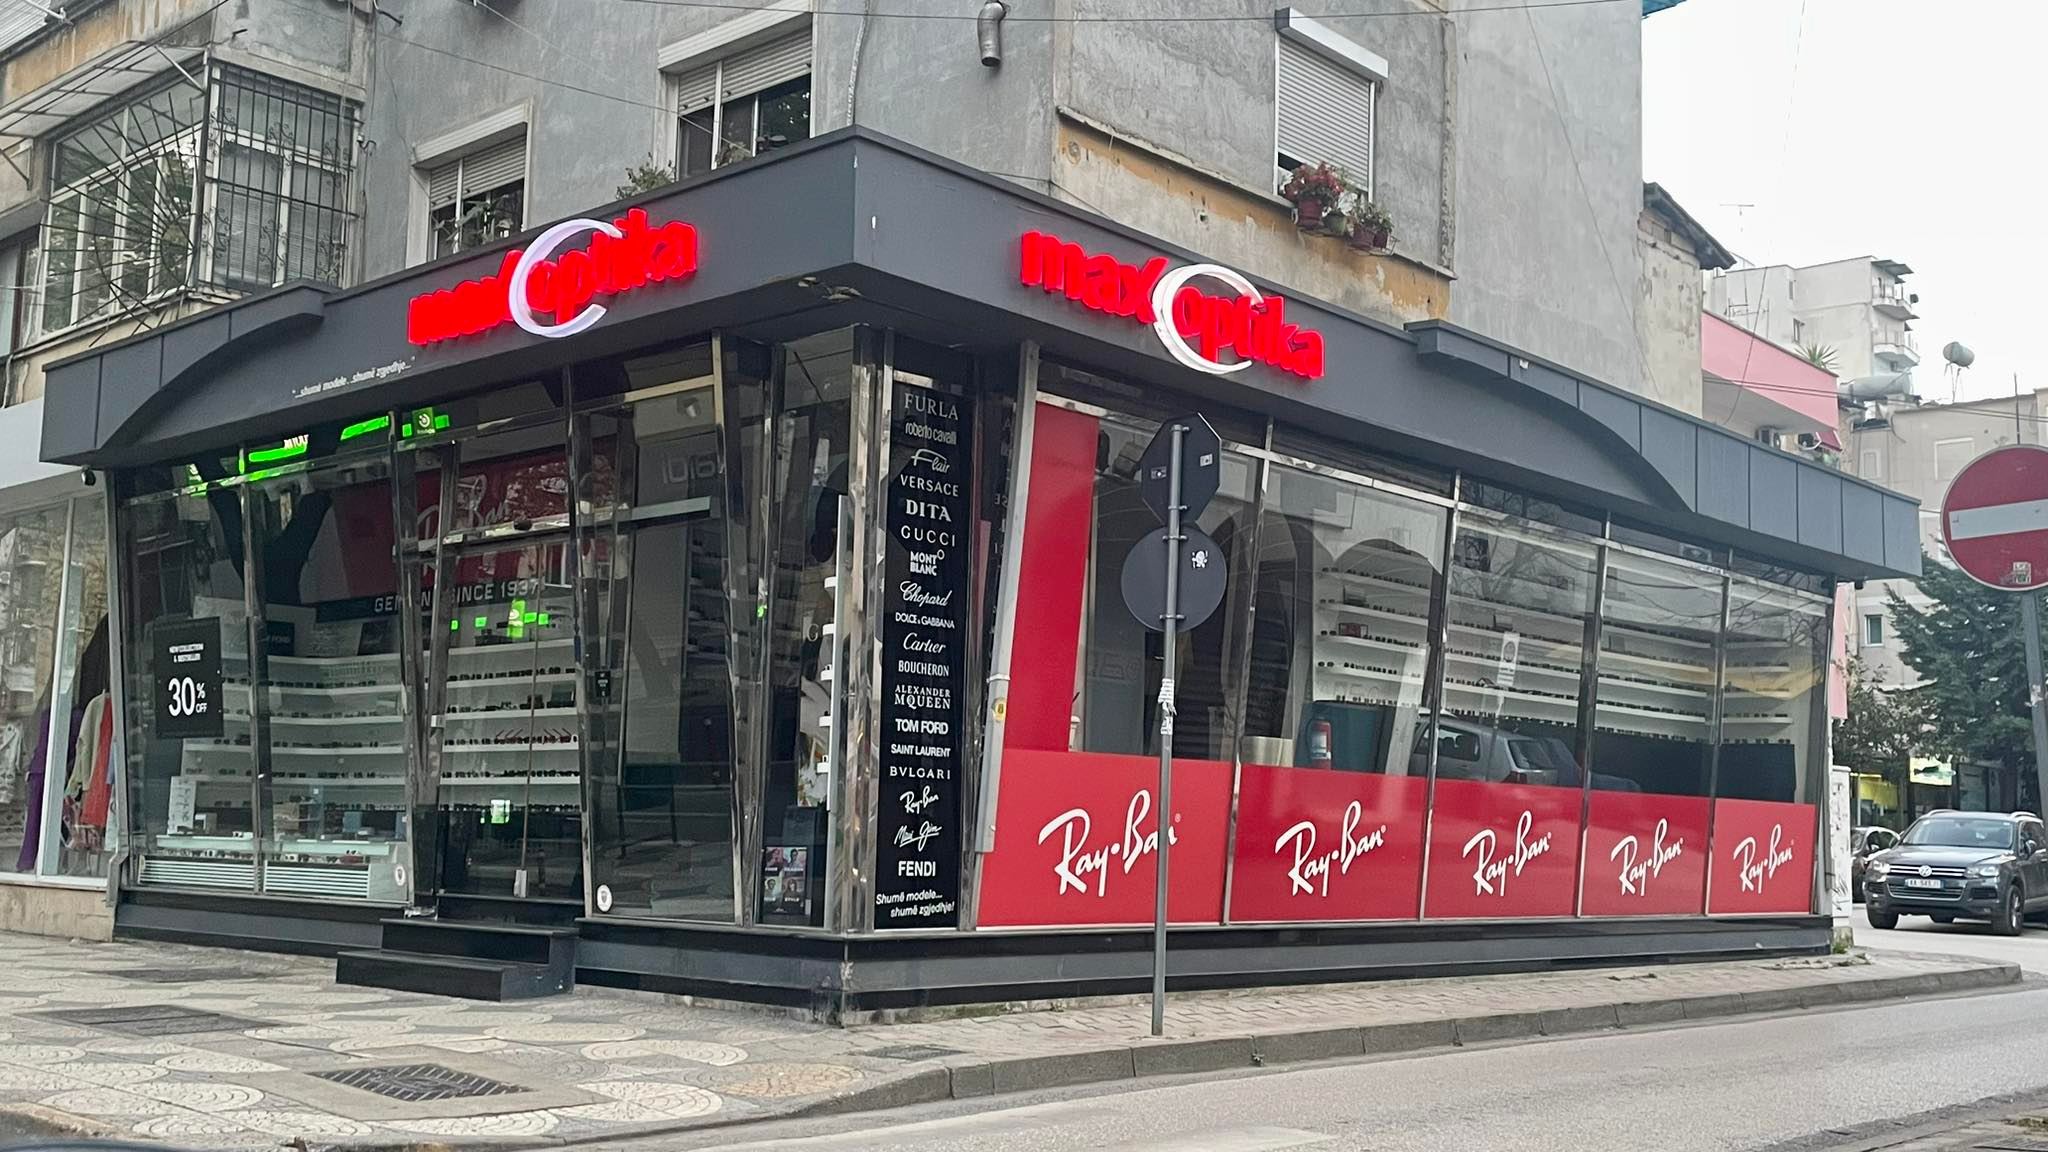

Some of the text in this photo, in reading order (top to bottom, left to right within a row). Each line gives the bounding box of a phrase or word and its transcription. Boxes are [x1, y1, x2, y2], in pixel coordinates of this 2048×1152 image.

[1020, 229, 1169, 324] max
[904, 392, 959, 421] FURLA
[905, 422, 957, 445] roberto cavalli
[910, 448, 950, 474] Flair
[900, 474, 959, 498] VERSACE
[905, 499, 951, 522] DITA
[900, 525, 956, 548] GUCCI
[910, 550, 938, 565] MONT
[909, 561, 937, 576] BLANC
[501, 577, 540, 598] 1937
[899, 580, 953, 608] Chopard
[903, 632, 947, 654] Cartier
[897, 660, 950, 677] BOUCHERON
[894, 684, 951, 698] ALEXANDER
[195, 702, 208, 714] OFF
[895, 718, 949, 735] TOM FORD
[891, 744, 951, 758] SAINT LAURENT
[889, 766, 951, 780] BVLGARI
[897, 861, 937, 878] FENDI
[876, 891, 905, 905] Shumë
[890, 900, 955, 918] shumë zgjedhje!
